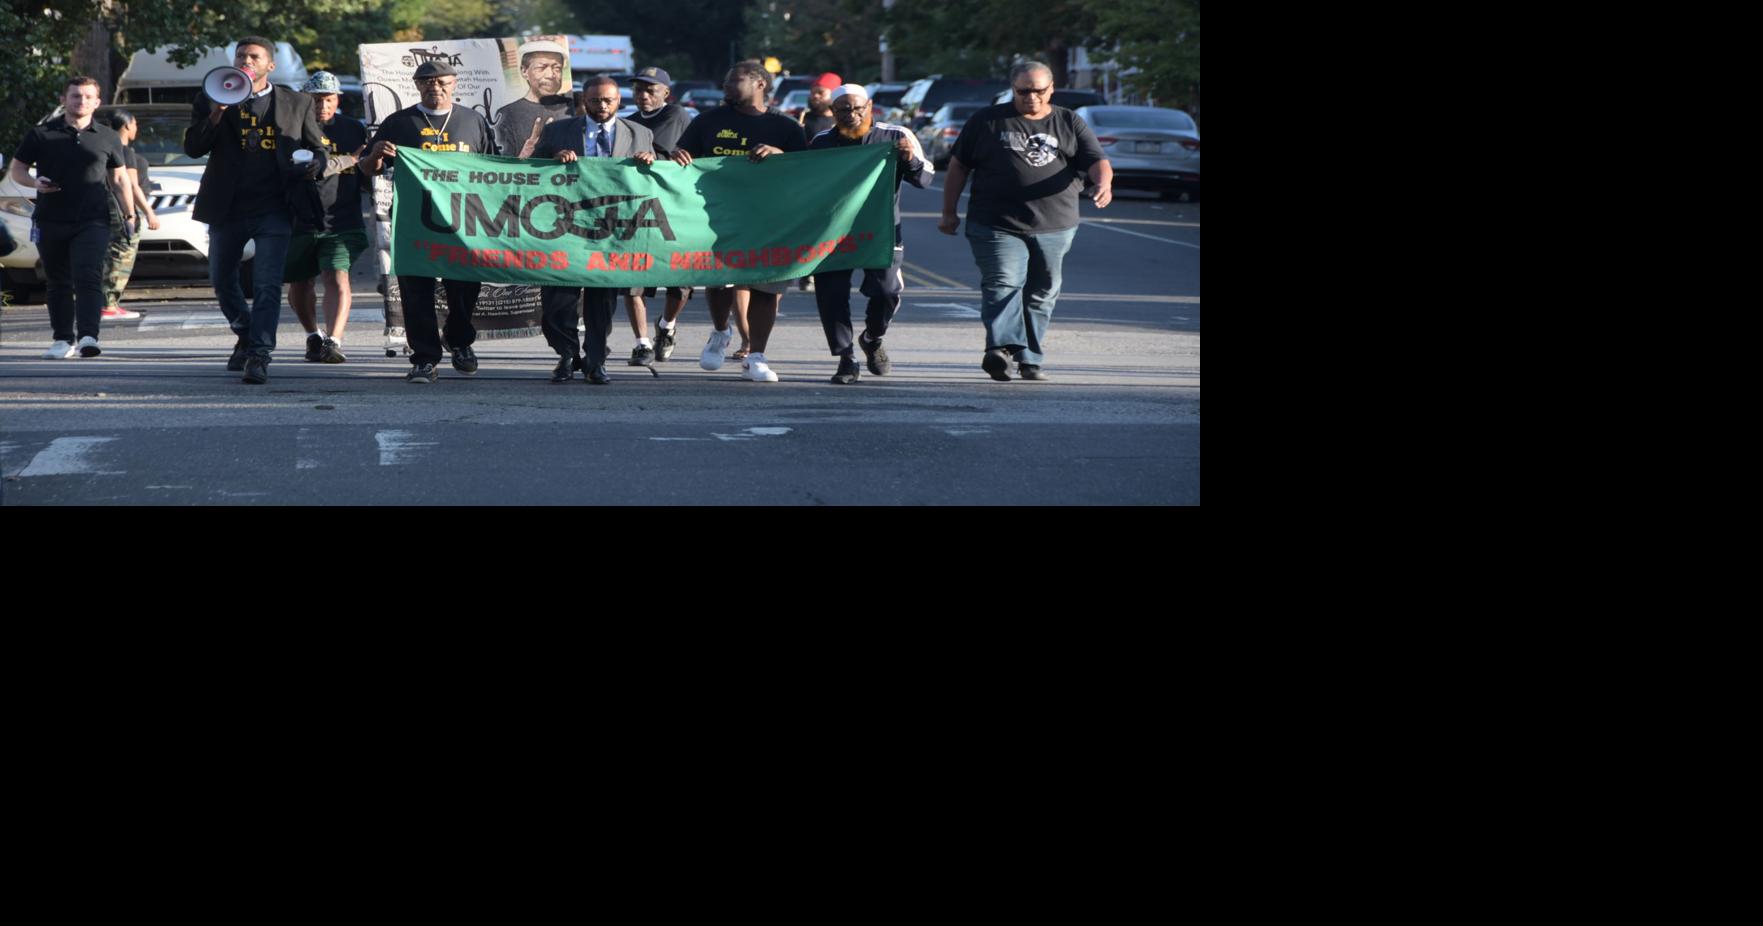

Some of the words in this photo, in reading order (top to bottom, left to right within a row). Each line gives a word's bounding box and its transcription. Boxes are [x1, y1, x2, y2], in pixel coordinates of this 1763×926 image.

[422, 141, 457, 152] Come
[458, 141, 470, 152] In
[420, 168, 459, 183] THE
[468, 171, 541, 186] HOUSE
[550, 173, 580, 187] OF
[414, 240, 569, 271] "FRIENDS
[585, 251, 654, 272] AND
[669, 232, 874, 271] NEIGHBORS"
